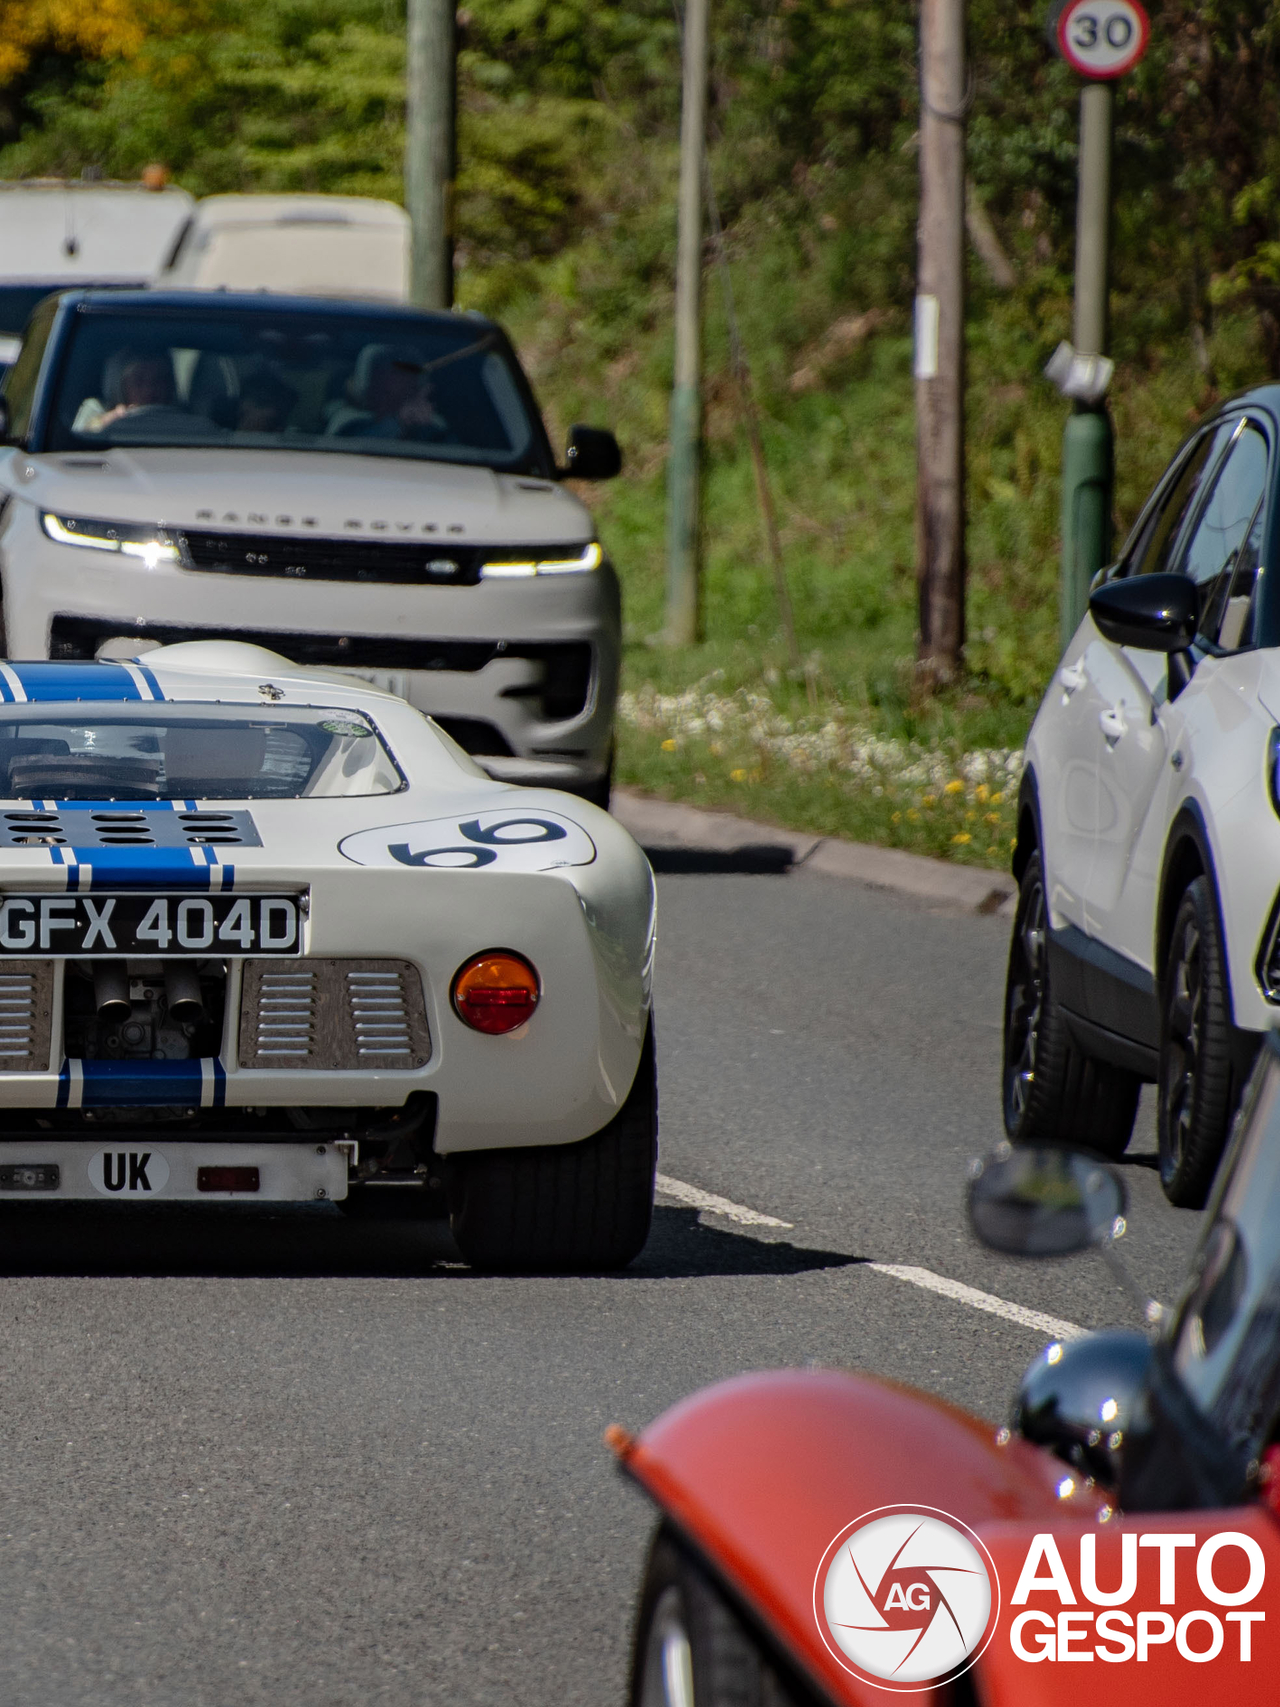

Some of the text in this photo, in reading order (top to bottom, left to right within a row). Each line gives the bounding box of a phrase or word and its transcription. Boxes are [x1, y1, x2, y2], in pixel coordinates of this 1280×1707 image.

[1072, 13, 1132, 49] 30
[195, 508, 467, 535] RANGE ROVER
[387, 818, 568, 868] 66
[0, 899, 296, 948] GFX 404D
[103, 1153, 152, 1191] UK
